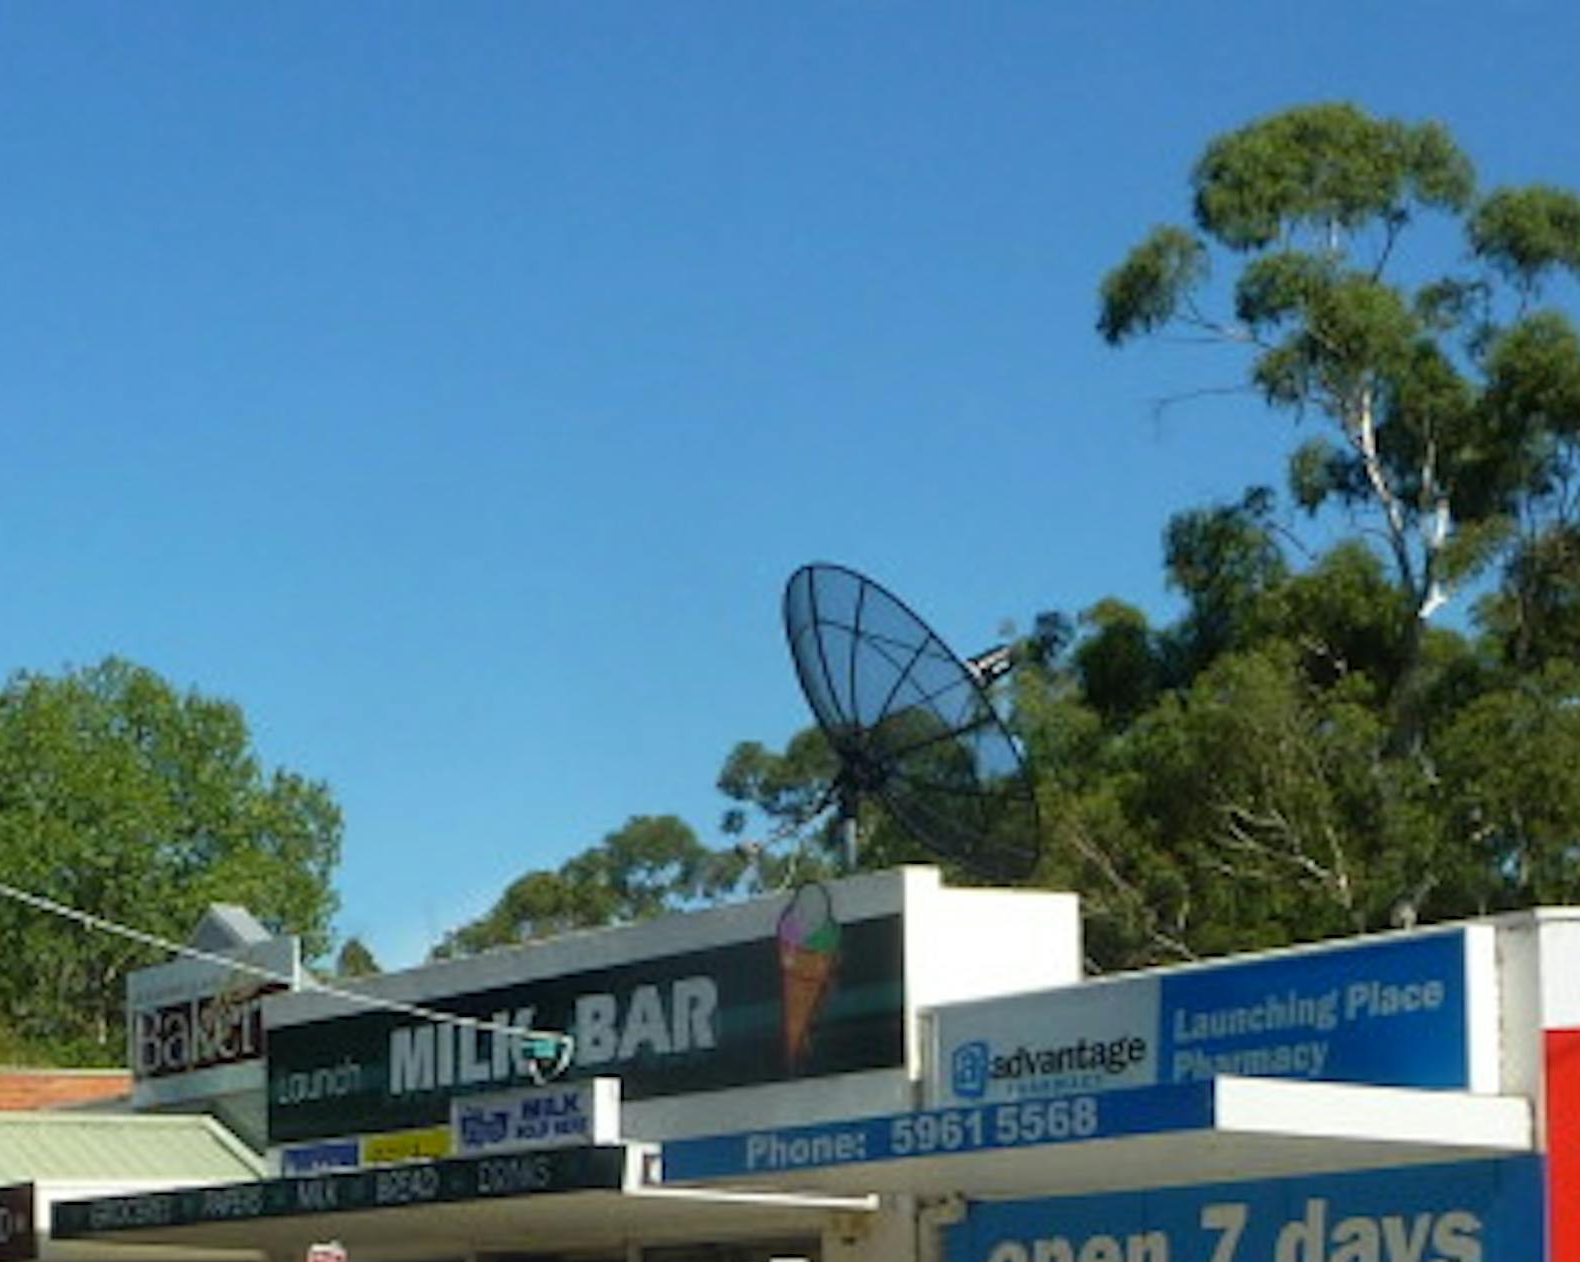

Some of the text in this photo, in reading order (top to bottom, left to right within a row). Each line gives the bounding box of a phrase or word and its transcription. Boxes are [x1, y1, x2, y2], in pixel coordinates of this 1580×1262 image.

[389, 975, 718, 1096] MILK BAR
[1172, 977, 1445, 1044] Launching Place
[990, 1032, 1147, 1081] advantage
[746, 1094, 1098, 1171] Phone: 5961 5568
